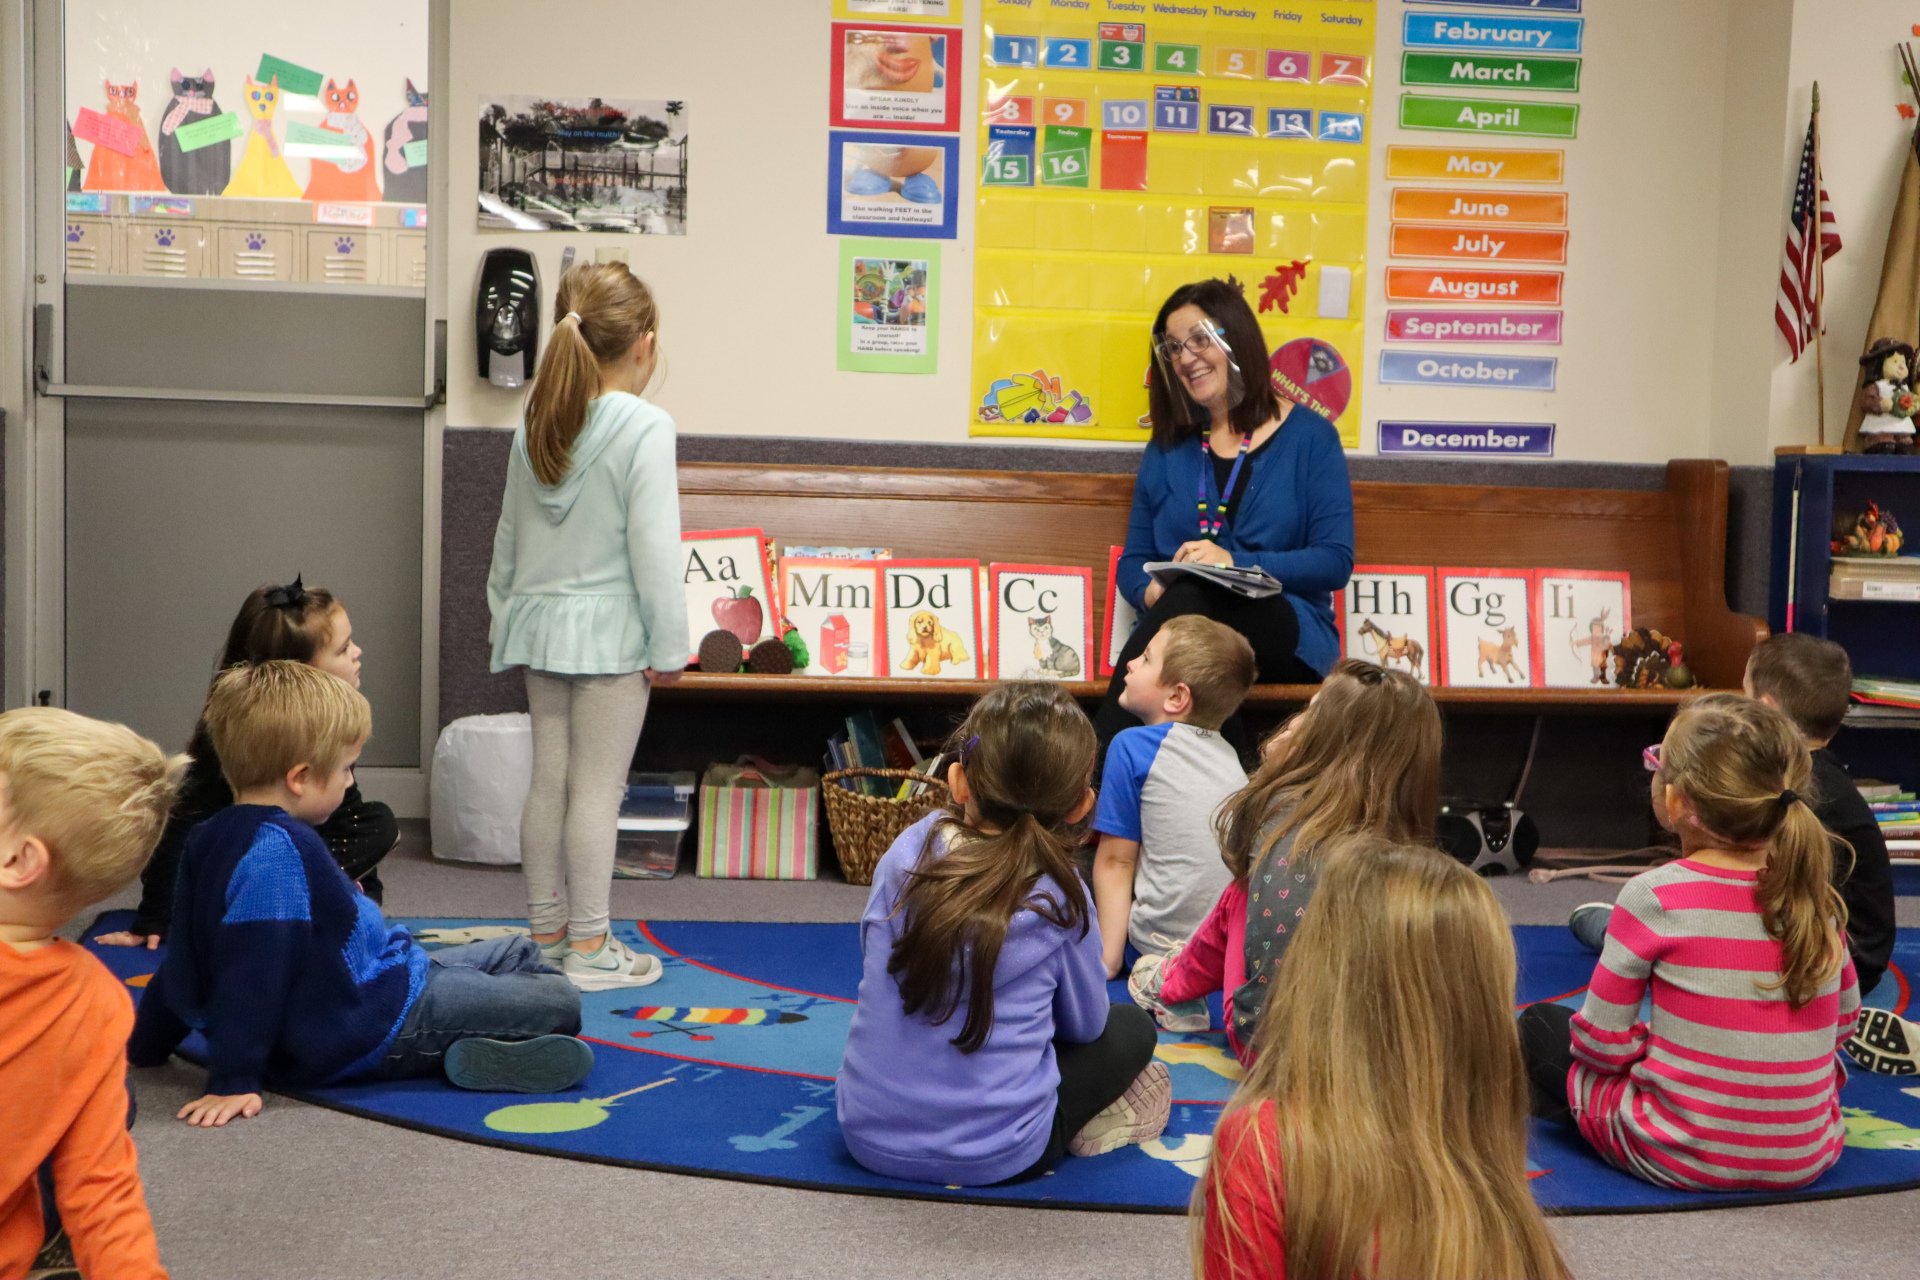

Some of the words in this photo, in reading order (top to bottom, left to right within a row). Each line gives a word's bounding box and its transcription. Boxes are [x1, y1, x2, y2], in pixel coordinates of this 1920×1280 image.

[1107, 1, 1146, 13] Tuesday
[1153, 4, 1208, 17] Wednesday
[1213, 6, 1256, 20] Thursday
[1273, 10, 1303, 22] Friday
[1320, 13, 1363, 26] Saturday
[1434, 21, 1552, 47] February
[1009, 42, 1020, 59] 1
[1059, 44, 1077, 62] 2
[1112, 46, 1131, 65] 3
[1167, 50, 1186, 68] 4
[1227, 53, 1245, 71] 5
[1278, 57, 1298, 75] 6
[1333, 60, 1352, 77] 7
[1450, 62, 1531, 82] March
[1002, 101, 1020, 120] 8
[1055, 103, 1074, 121] 9
[1110, 105, 1140, 124] 10
[1165, 106, 1188, 125] 11
[1216, 111, 1246, 130] 12
[1457, 106, 1520, 129] April
[995, 128, 1030, 137] Yesterday
[1057, 128, 1080, 137] Today
[1276, 113, 1305, 132] 13
[991, 161, 1020, 180] 15
[1049, 155, 1080, 175] 16
[1446, 155, 1504, 178] May
[1449, 197, 1510, 217] June
[1452, 234, 1505, 257] July
[1428, 276, 1519, 299] August
[1404, 317, 1543, 339] September
[1417, 359, 1519, 381] October
[1272, 368, 1310, 404] WHAT'S
[1310, 399, 1331, 418] THE
[1402, 429, 1530, 447] December
[683, 546, 740, 584] Aa
[789, 572, 871, 609] Mm
[889, 573, 951, 609] Dd
[1003, 577, 1059, 614] Cc
[1351, 579, 1413, 615] Hh
[1450, 581, 1507, 627] Gg
[1550, 583, 1575, 619] Ii
